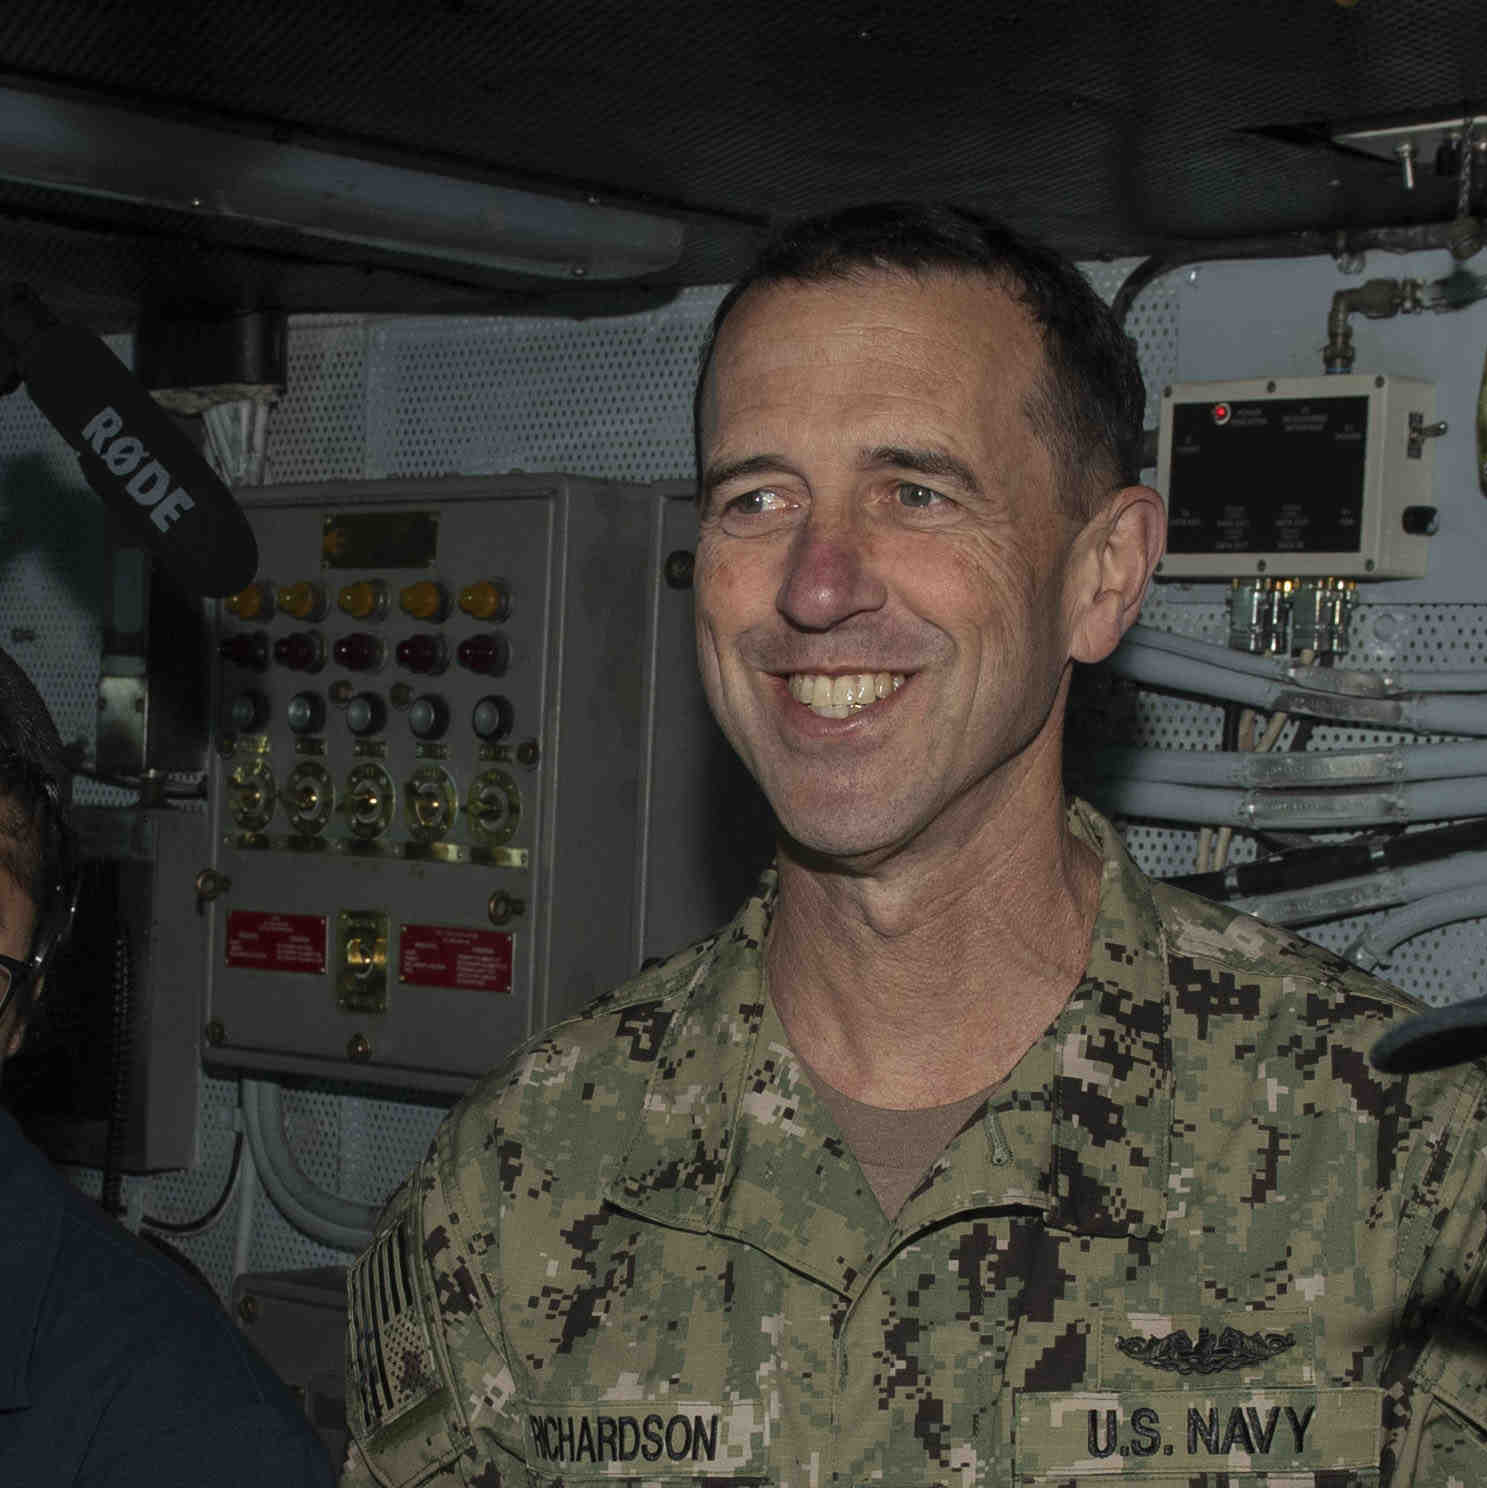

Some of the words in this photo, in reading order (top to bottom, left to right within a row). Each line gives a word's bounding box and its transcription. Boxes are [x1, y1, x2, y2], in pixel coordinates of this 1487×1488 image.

[532, 1411, 719, 1466] RICHARDSON
[1087, 1407, 1173, 1458] U.S.
[1187, 1405, 1317, 1456] NAVY
